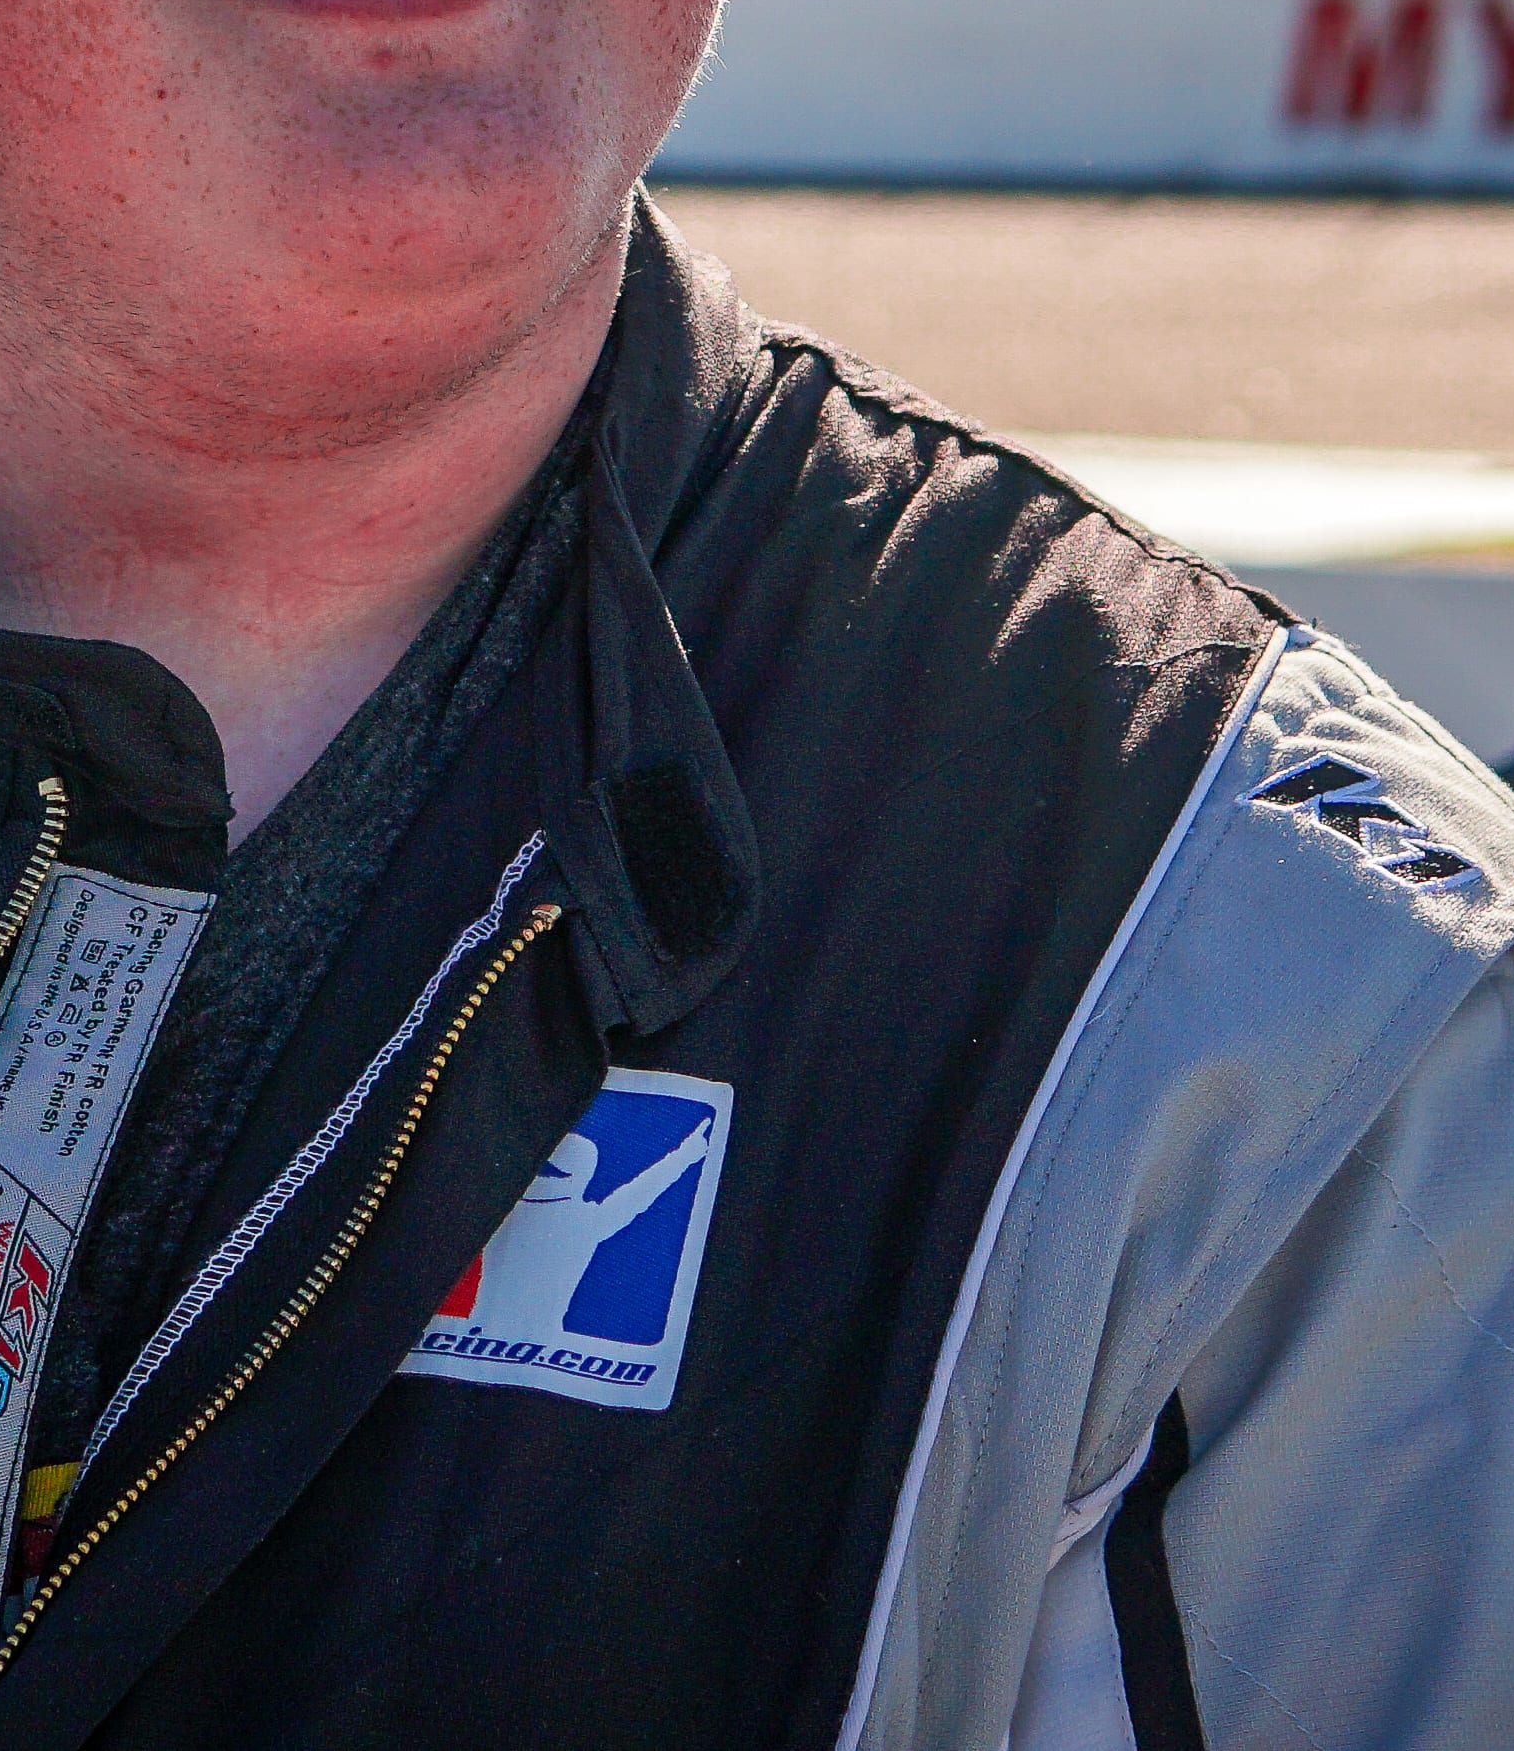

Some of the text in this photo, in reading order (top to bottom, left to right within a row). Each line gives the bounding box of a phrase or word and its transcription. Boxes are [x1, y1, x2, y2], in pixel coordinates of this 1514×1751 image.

[56, 889, 94, 964] Designed
[40, 983, 59, 1007] the
[49, 965, 65, 981] in
[39, 907, 146, 1132] CF Treated by FR Finish
[57, 911, 177, 1154] Racing Garment FR cotton
[415, 1326, 658, 1384] cing.com
